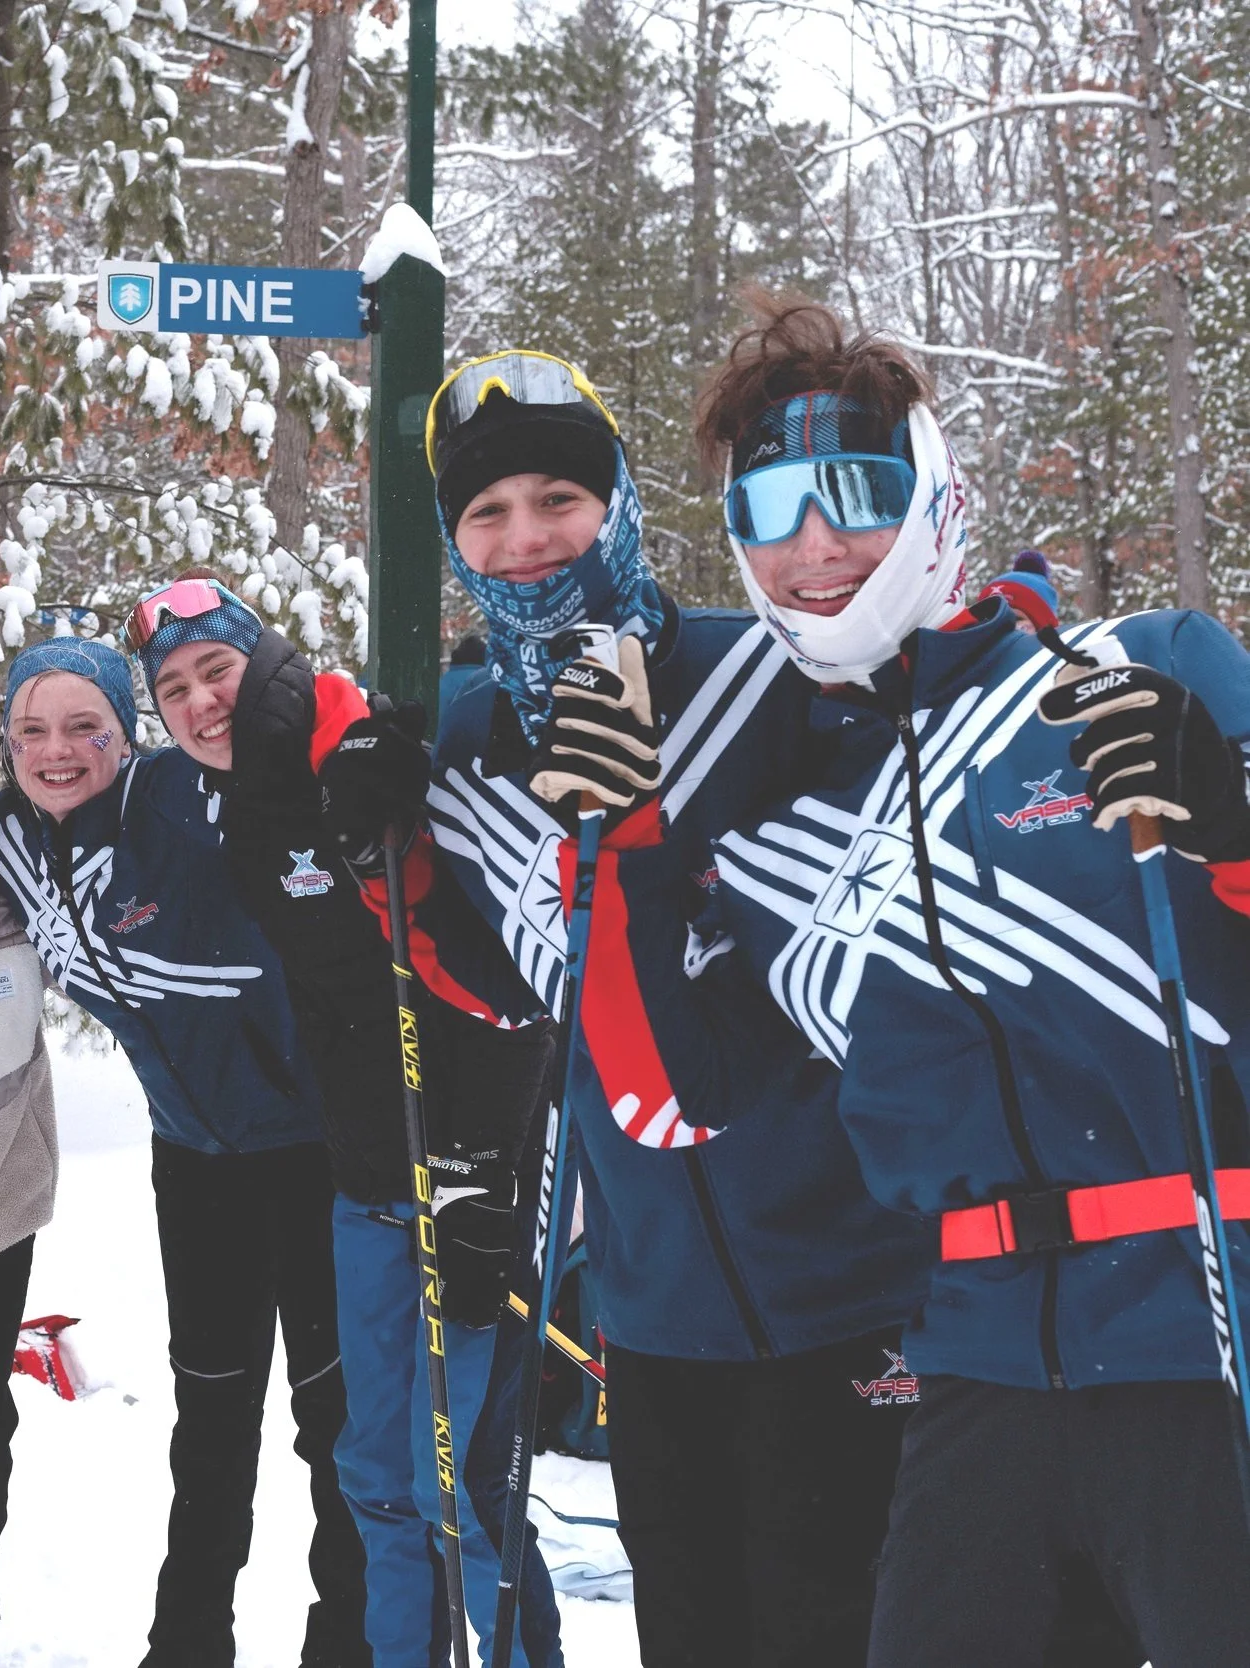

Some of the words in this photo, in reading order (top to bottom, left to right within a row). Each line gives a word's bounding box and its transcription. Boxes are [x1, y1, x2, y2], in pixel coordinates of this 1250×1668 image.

[170, 277, 294, 324] PINE
[496, 584, 582, 627] SALOMON
[400, 1008, 422, 1090] KV+
[427, 1159, 472, 1175] SALOMO
[414, 1163, 445, 1357] BORA
[434, 1412, 456, 1493] KV+
[509, 1434, 523, 1492] DYNAMIC
